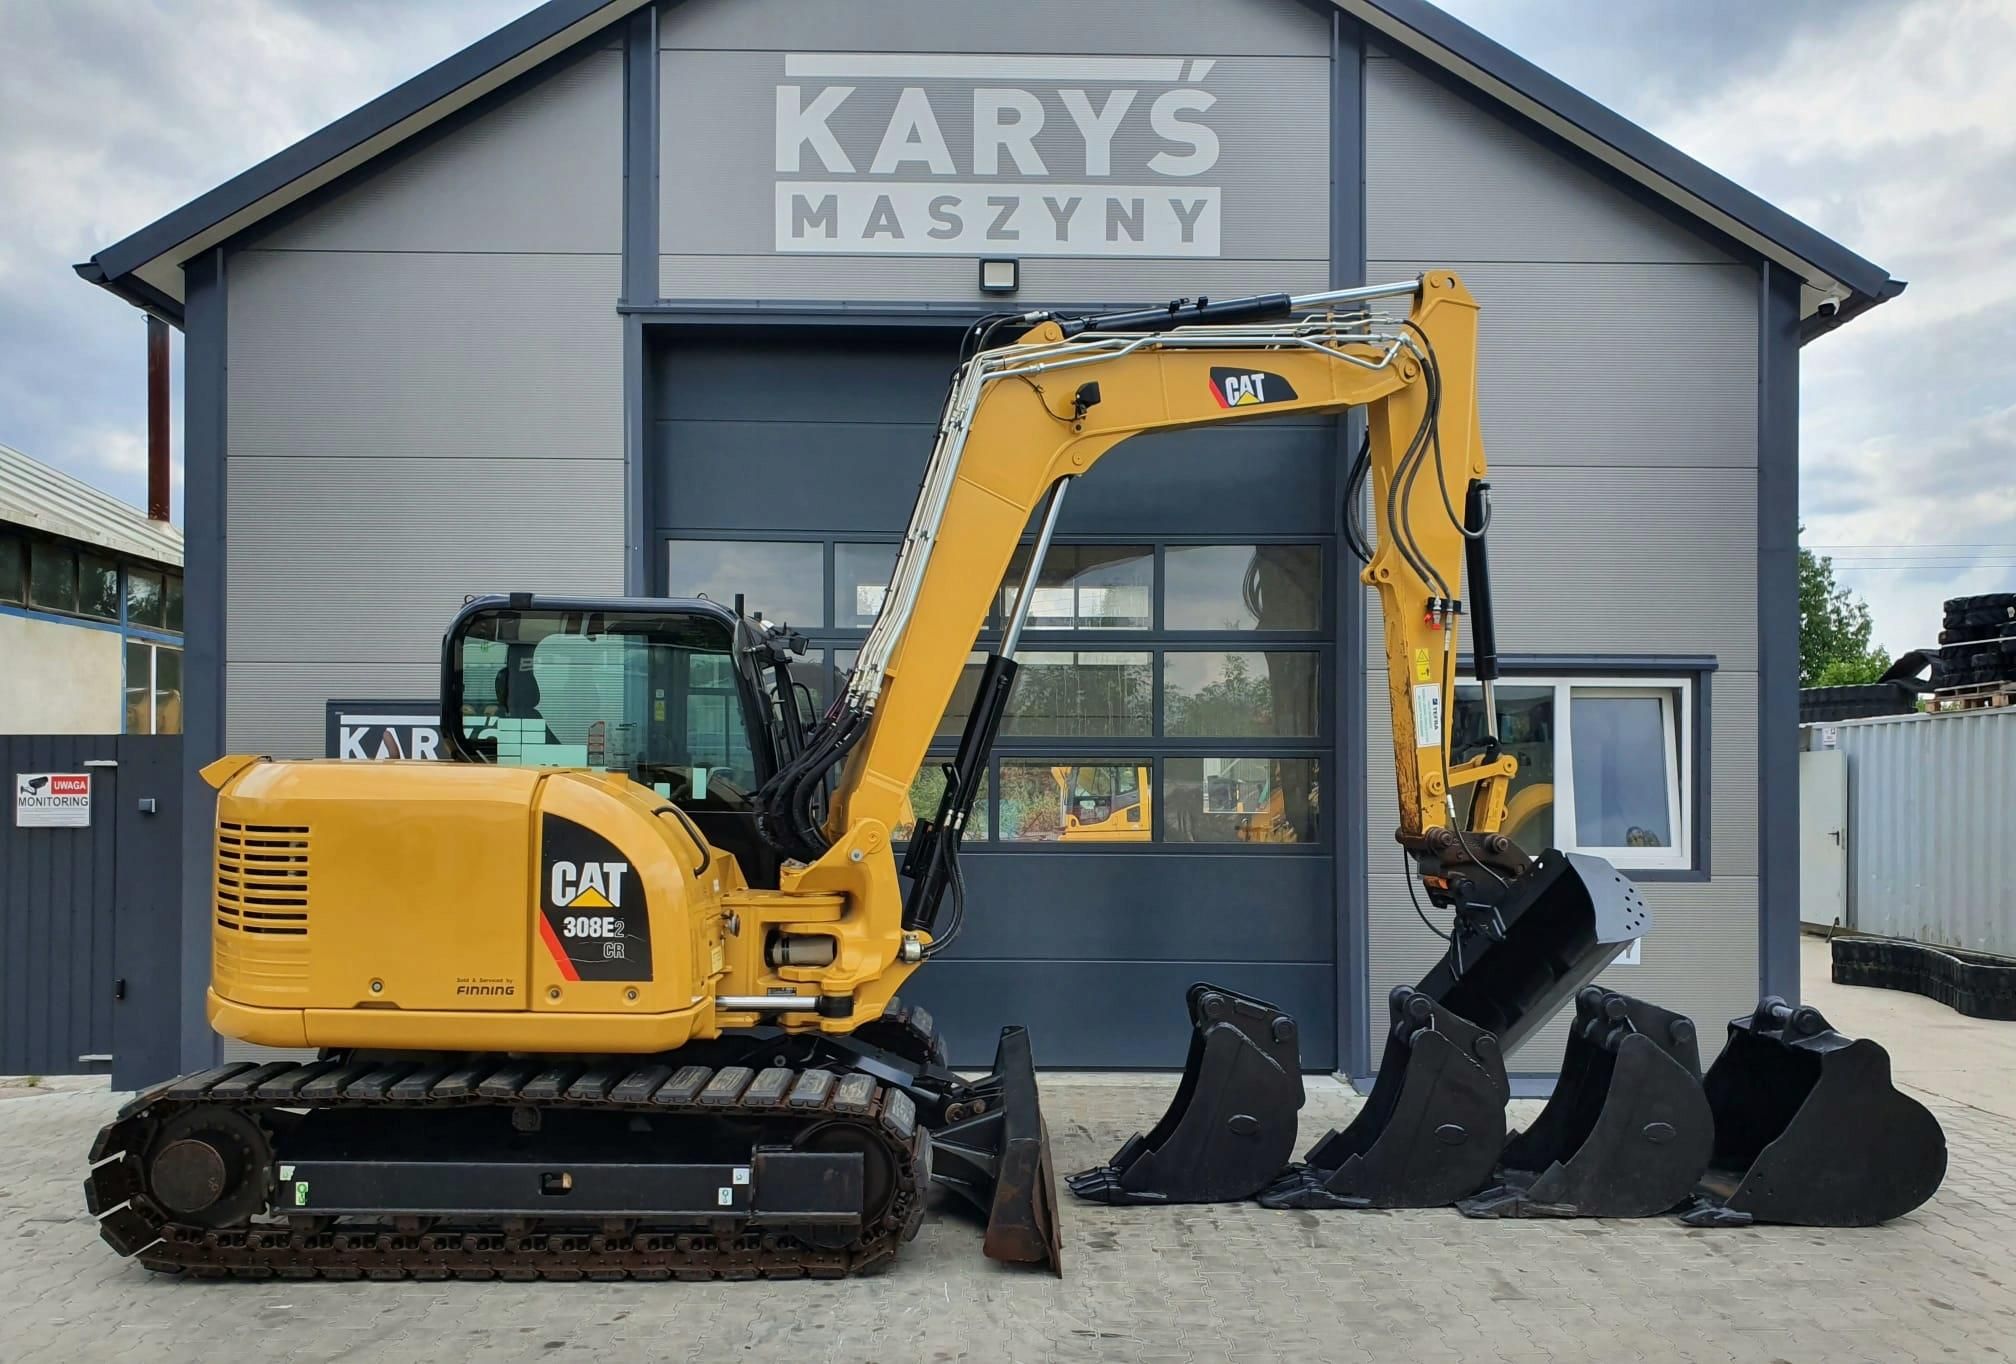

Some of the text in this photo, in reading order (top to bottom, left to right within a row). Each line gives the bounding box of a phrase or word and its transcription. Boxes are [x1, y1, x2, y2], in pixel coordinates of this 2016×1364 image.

[776, 60, 1220, 176] KARYŚ
[791, 194, 1208, 243] MASZYNY
[1225, 373, 1265, 407] CAT
[54, 781, 86, 790] UWAGA
[19, 797, 89, 807] MONITORING
[551, 861, 628, 908] CAT
[603, 942, 625, 959] CR
[456, 986, 515, 996] FINNING
